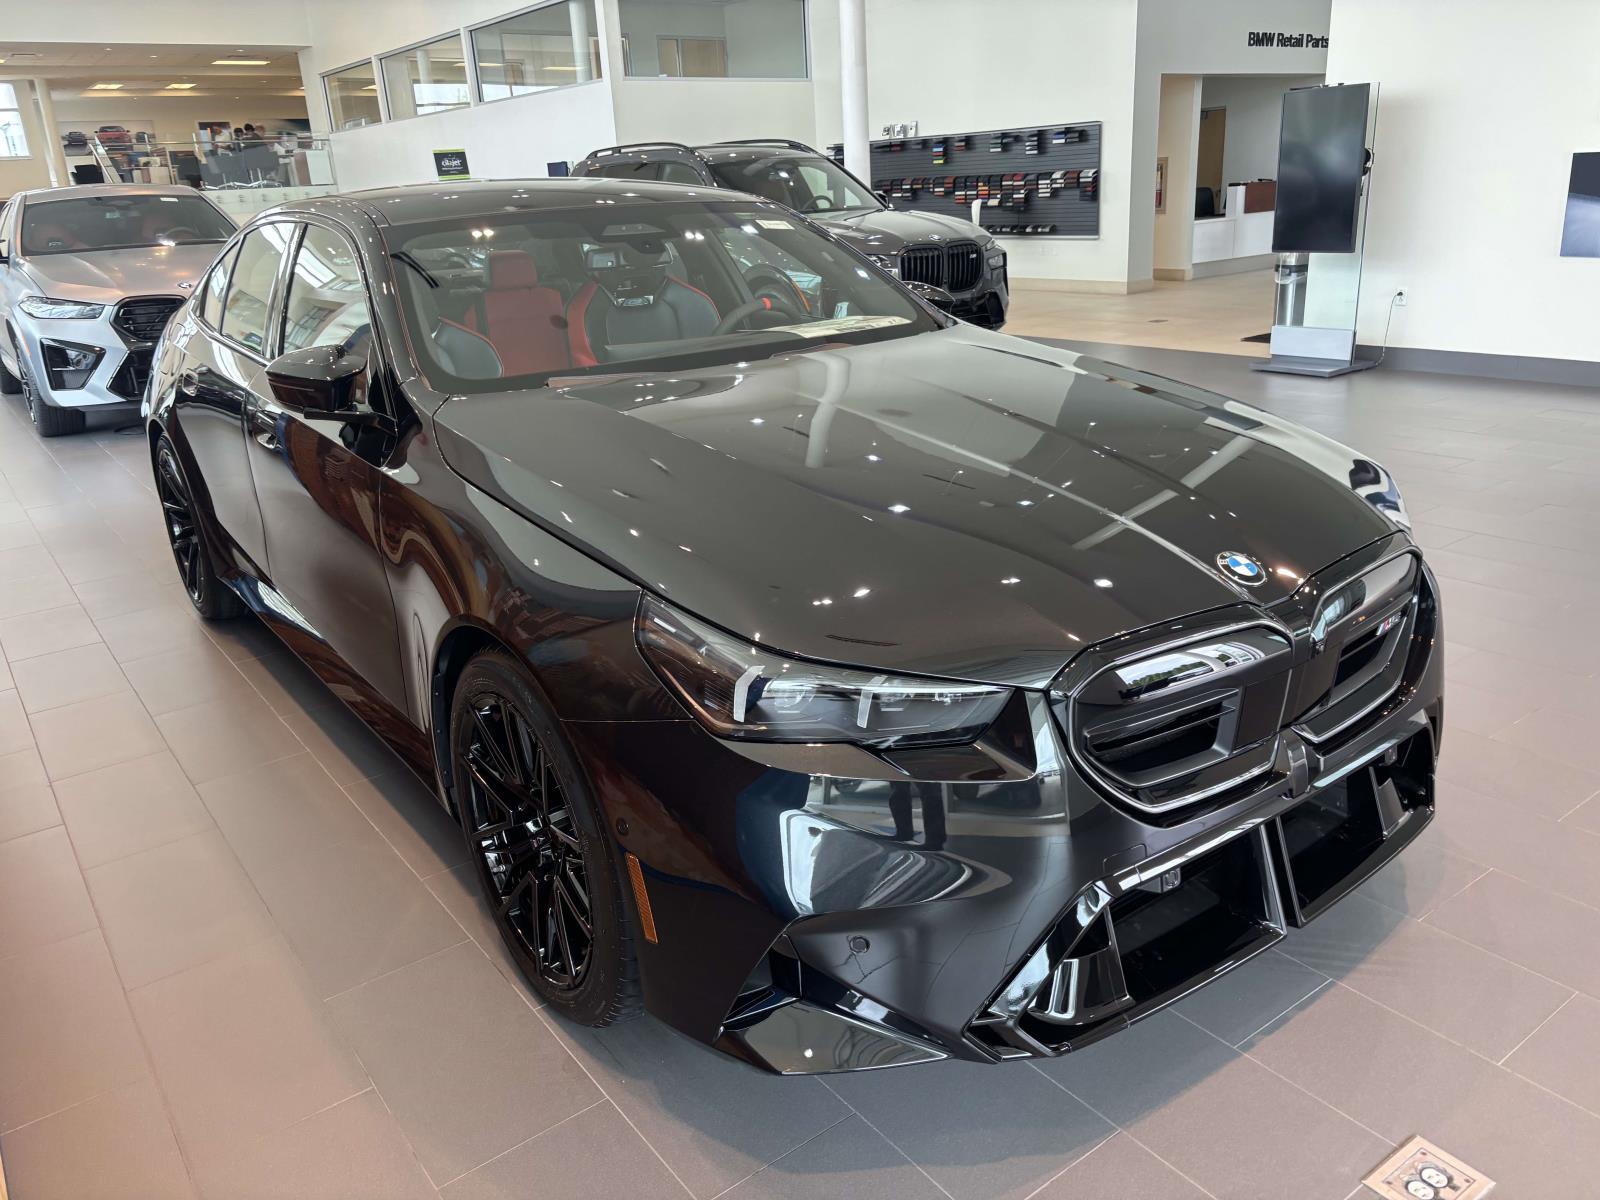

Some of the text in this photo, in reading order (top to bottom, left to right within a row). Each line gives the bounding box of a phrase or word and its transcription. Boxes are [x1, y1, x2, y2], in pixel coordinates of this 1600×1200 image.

[1248, 32, 1329, 48] BMW Retail Parts
